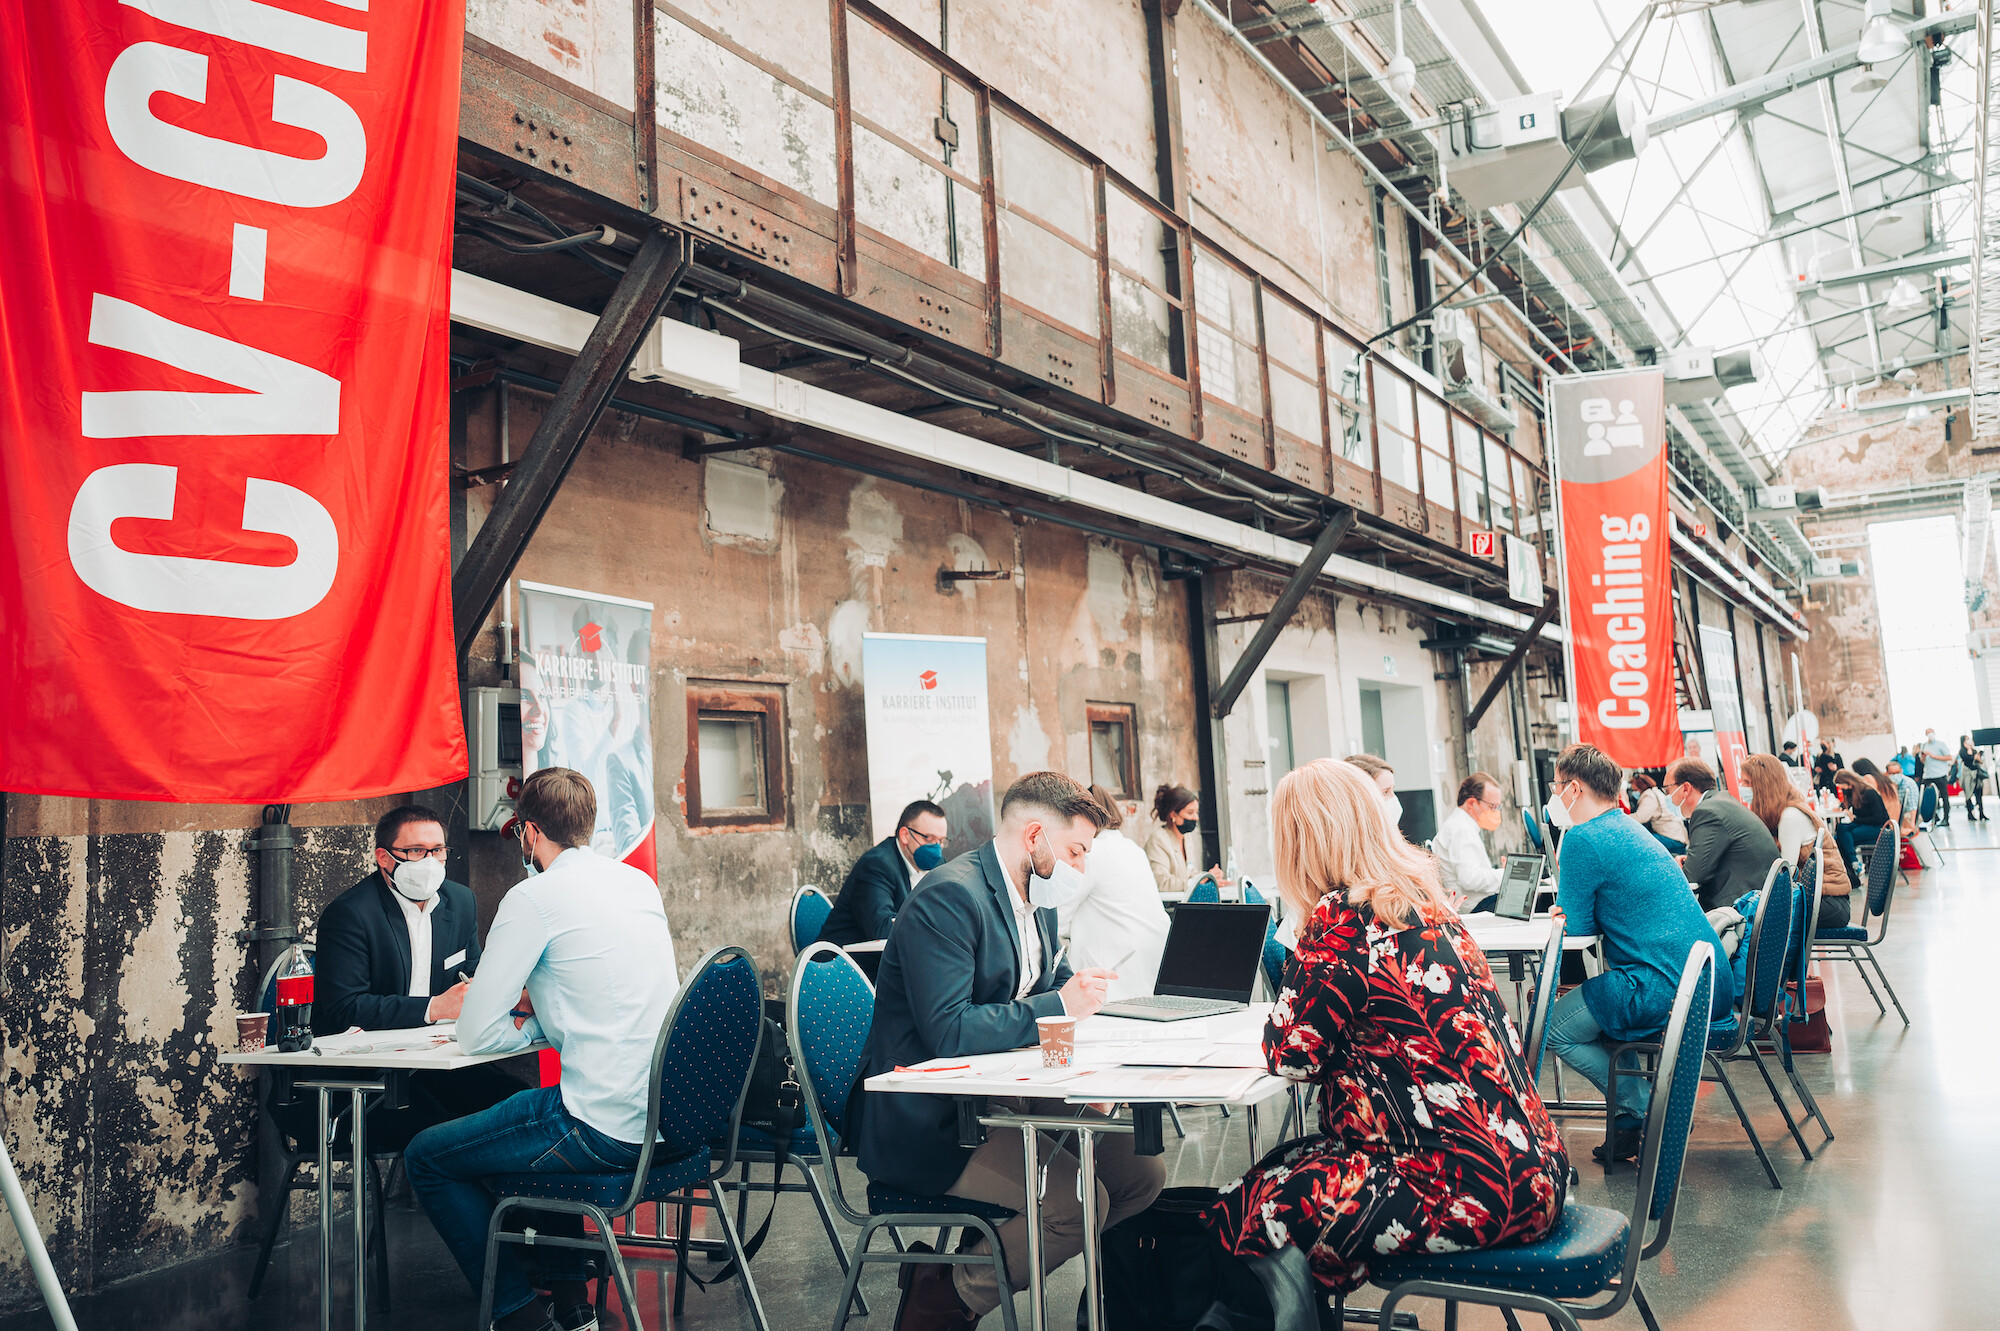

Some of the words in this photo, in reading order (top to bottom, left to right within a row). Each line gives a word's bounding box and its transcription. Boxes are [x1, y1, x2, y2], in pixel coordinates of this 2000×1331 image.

[1522, 113, 1533, 129] 6
[1592, 513, 1651, 729] Coaching
[535, 653, 646, 685] KARRIERE-INSTITUT
[592, 688, 648, 705] GESTEN
